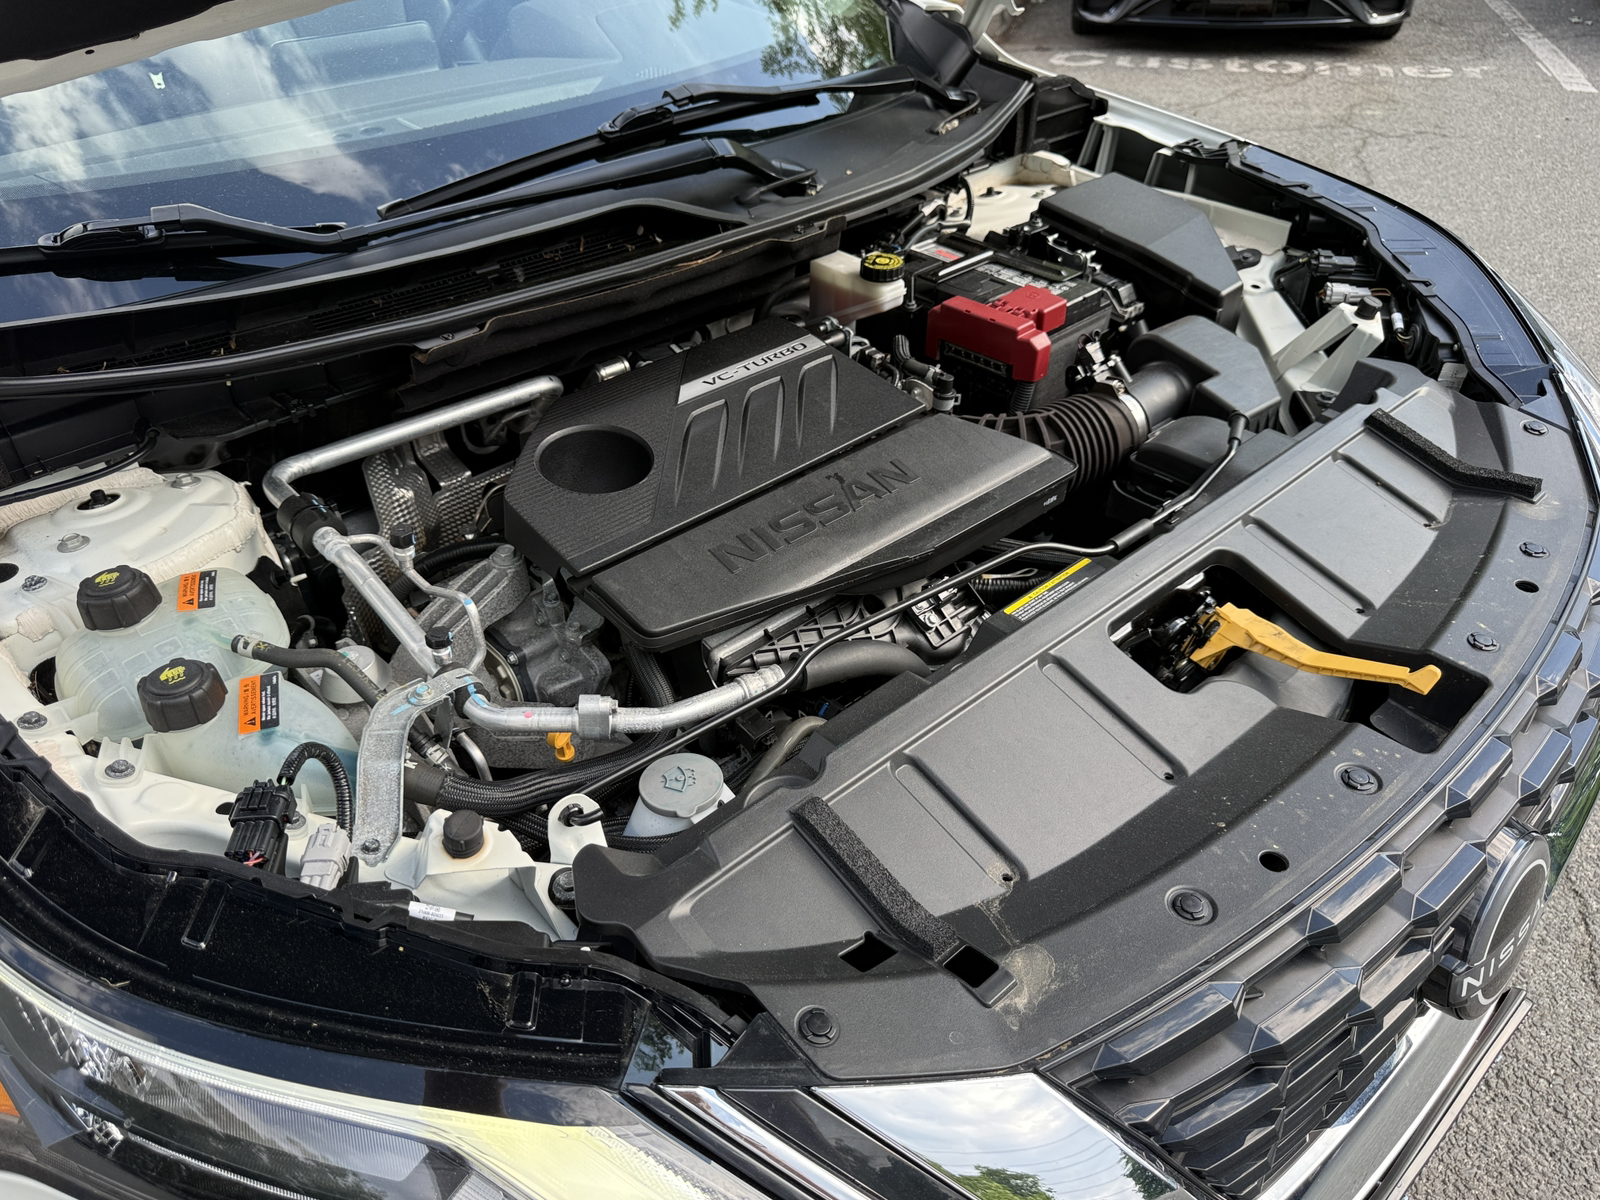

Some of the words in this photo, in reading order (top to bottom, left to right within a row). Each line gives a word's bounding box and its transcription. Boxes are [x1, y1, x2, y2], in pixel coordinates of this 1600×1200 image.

[1049, 51, 1489, 79] Customer
[702, 342, 807, 386] VC-TURBO
[708, 458, 922, 574] NISSAN
[1461, 898, 1544, 998] NISSA
